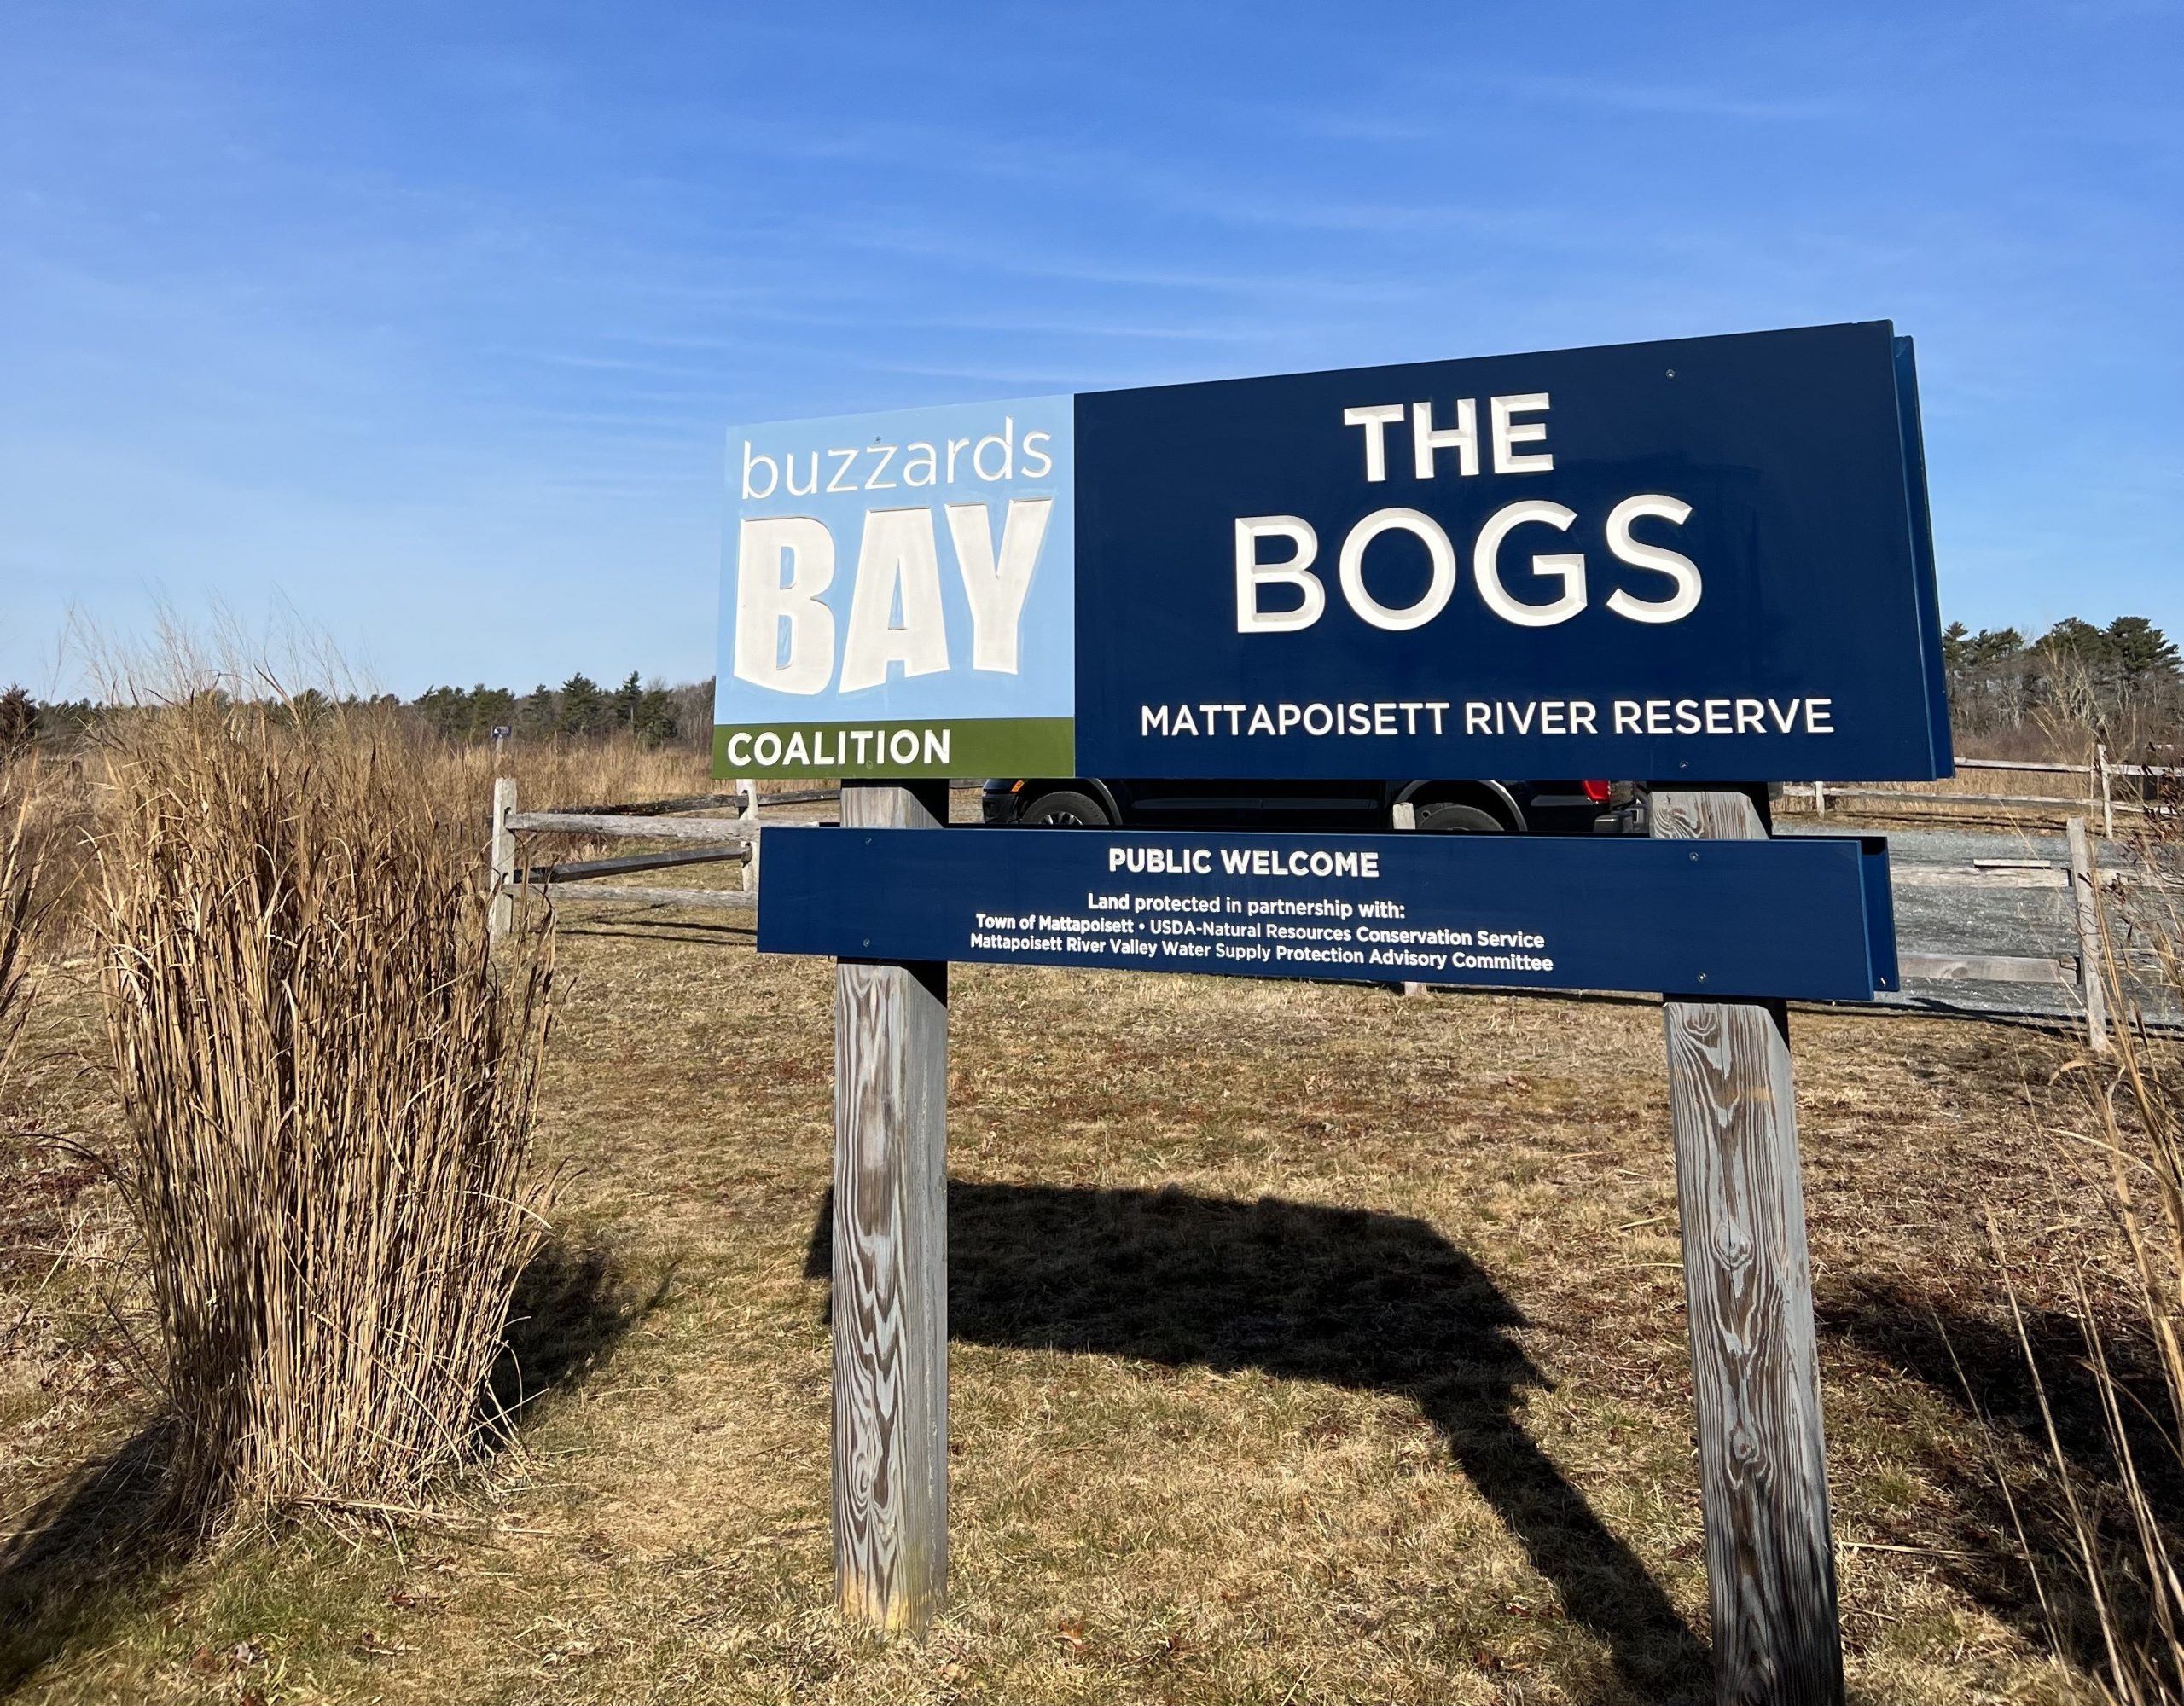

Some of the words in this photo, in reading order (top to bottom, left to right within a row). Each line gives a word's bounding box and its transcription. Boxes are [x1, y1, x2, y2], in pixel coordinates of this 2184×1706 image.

[1344, 392, 1554, 482] THE
[741, 415, 1053, 500] buzzards
[1234, 494, 1703, 634] BOGS
[733, 496, 1054, 696] BAY
[1141, 702, 1450, 736] MATTAPOISETT
[1466, 700, 1598, 735] RIVER
[1614, 698, 1835, 734] RESERVE
[727, 729, 951, 767] COALITION
[1108, 847, 1212, 874] PUBLIC
[1220, 849, 1380, 878] WELCOME
[1088, 892, 1130, 910] Land
[1134, 895, 1221, 914] protected
[1226, 896, 1242, 914] in
[1247, 898, 1353, 920] partnership
[1357, 900, 1406, 919] with:
[975, 913, 1016, 930] Town
[1019, 914, 1037, 931] of
[1038, 914, 1135, 935] Mattapoisett
[1150, 919, 1261, 938] USDA-Natural
[1266, 923, 1352, 942] Resources
[1356, 926, 1473, 946] Conservation
[1477, 930, 1545, 949] Service
[970, 932, 1063, 952] Mattapoisett
[1066, 937, 1107, 953] River
[1109, 938, 1158, 958] Valley
[1161, 940, 1211, 957] Water
[1215, 943, 1271, 962] Supply
[1275, 945, 1365, 964] Protection
[1368, 948, 1448, 970] Advisory
[1451, 951, 1554, 972] Committee
